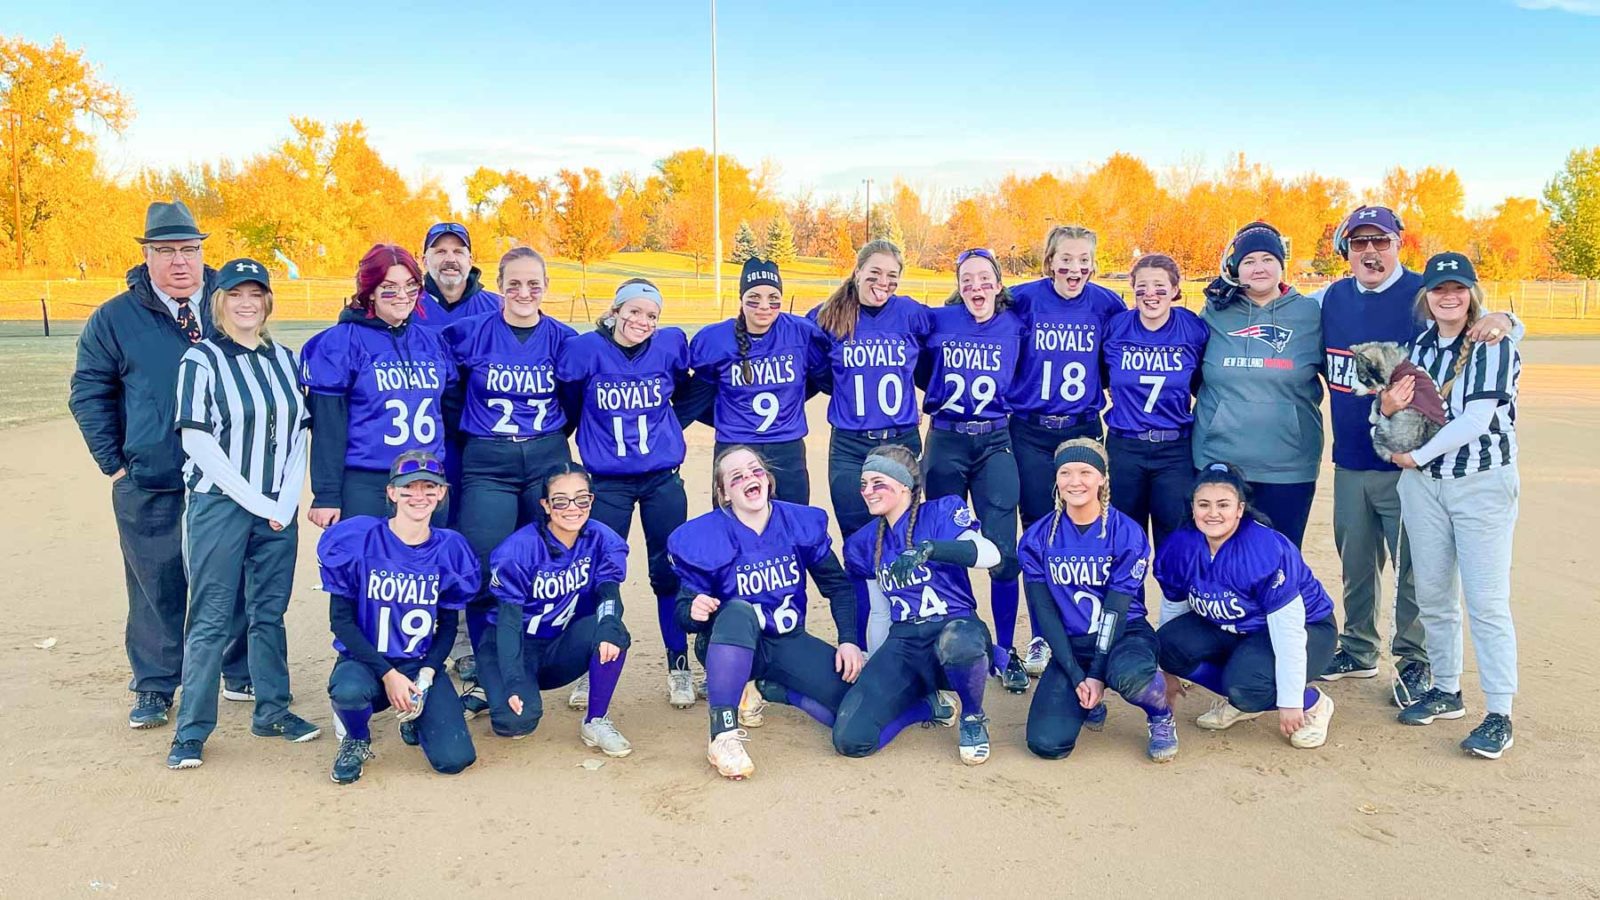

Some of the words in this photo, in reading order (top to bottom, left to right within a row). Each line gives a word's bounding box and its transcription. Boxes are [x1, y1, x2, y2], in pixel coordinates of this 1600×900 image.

[1036, 322, 1096, 330] COLORADO
[843, 338, 905, 346] COLORADO
[942, 341, 1002, 350] COLORADO
[1035, 329, 1094, 352] ROYALS
[1122, 345, 1183, 353] COLORADO
[373, 360, 435, 368] COLORADO
[488, 363, 554, 371] COLORADO
[739, 354, 794, 366] CLORADO
[843, 345, 907, 368] ROYALS
[943, 346, 1001, 371] ROYALS
[1121, 351, 1183, 372] ROYALS
[375, 367, 440, 392] ROYALS
[486, 367, 556, 393] ROYALS
[596, 379, 661, 388] COLORADO
[731, 360, 795, 387] ROYALS
[1040, 360, 1087, 402] 18
[597, 384, 662, 410] ROYALS
[854, 373, 903, 417] 10
[940, 373, 997, 415] 29
[1139, 375, 1167, 414] 7
[383, 397, 436, 446] 36
[487, 398, 553, 433] 27
[752, 392, 779, 432] 9
[612, 414, 650, 457] 11
[536, 556, 592, 578] COLOADO
[736, 553, 797, 571] COLORADO
[1047, 555, 1113, 563] COLORADO
[370, 568, 440, 580] COLORADO
[532, 562, 591, 600] ROYALS
[736, 560, 800, 596] ROYALS
[877, 565, 932, 592] OLS
[1048, 562, 1112, 586] ROYALS
[367, 572, 439, 605] ROYALS
[752, 593, 799, 635] 16
[1188, 591, 1246, 620] ROYALS
[376, 606, 432, 654] 19
